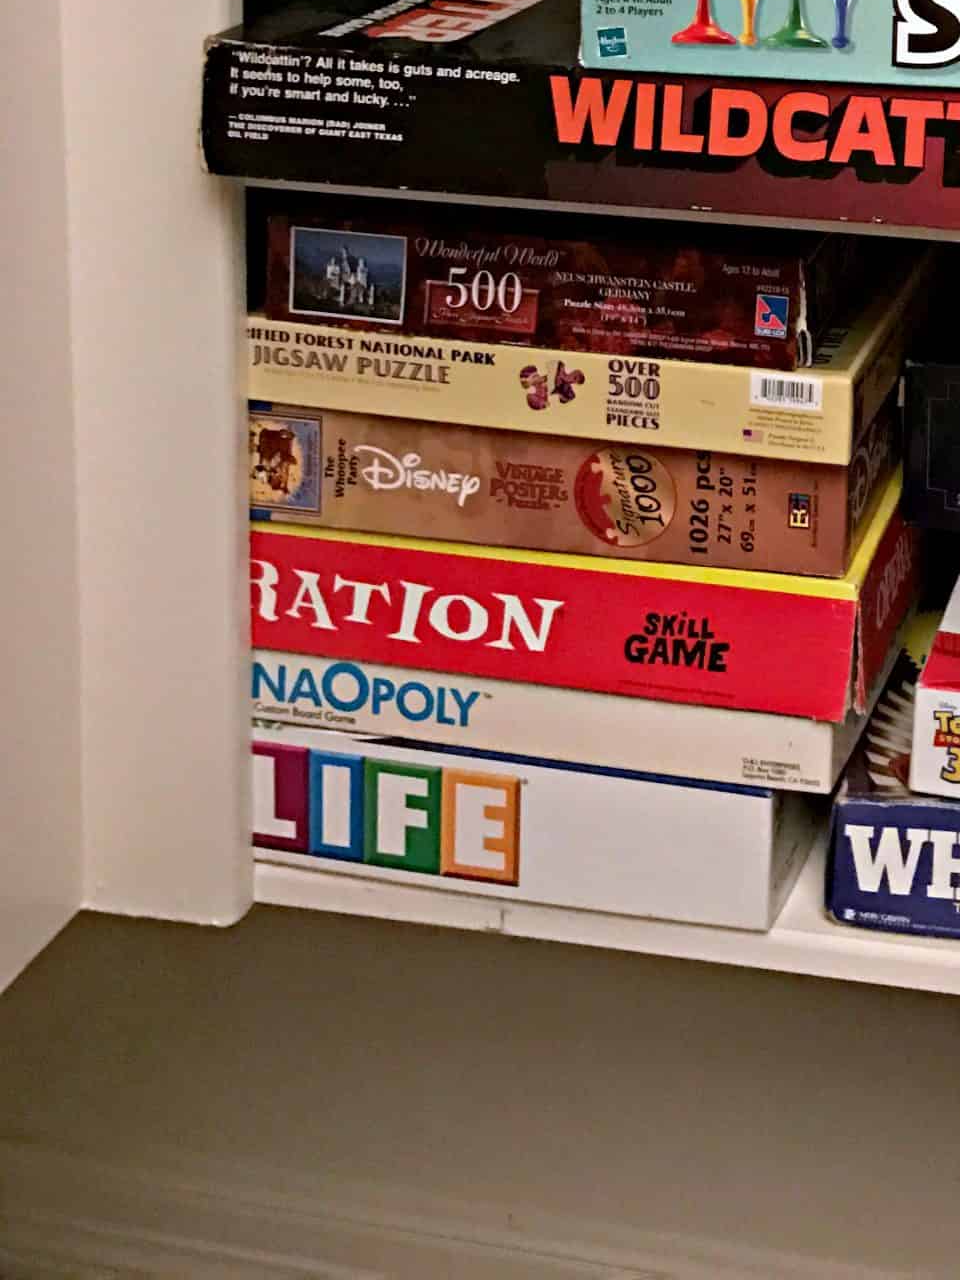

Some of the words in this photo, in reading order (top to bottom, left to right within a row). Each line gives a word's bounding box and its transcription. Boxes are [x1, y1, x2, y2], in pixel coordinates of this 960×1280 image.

[596, 5, 604, 15] 2
[605, 6, 616, 16] to
[617, 6, 626, 16] 4
[627, 6, 665, 17] Players
[230, 66, 239, 79] It
[242, 69, 283, 82] seems
[287, 71, 300, 83] to
[304, 72, 331, 87] help
[335, 75, 375, 91] some,
[378, 77, 404, 92] too,
[316, 57, 333, 69] All
[337, 58, 346, 70] it
[350, 59, 384, 73] takes
[388, 61, 400, 74] is
[403, 64, 433, 78] guts
[436, 67, 461, 79] and
[465, 69, 520, 84] acreage.
[241, 86, 281, 99] you're
[284, 89, 321, 101] smart
[324, 91, 350, 103] and
[227, 130, 242, 140] OIL
[244, 132, 270, 141] FIELD
[228, 121, 245, 130] THE
[247, 123, 303, 135] DISCOVERER
[304, 127, 316, 135] OF
[318, 129, 346, 138] GIANT
[348, 130, 372, 140] EAST
[373, 132, 404, 142] TEXAS
[415, 238, 500, 269] Wonderful
[502, 242, 561, 267] World
[446, 267, 522, 313] 500
[599, 286, 652, 300] GERMANY
[248, 328, 290, 344] IFIED
[295, 331, 354, 353] FOREST
[360, 339, 446, 362] NATIONAL
[451, 349, 496, 367] PARK
[252, 344, 349, 373] JIGSAW
[356, 356, 452, 385] PUZZLE
[608, 359, 661, 378] OVER
[608, 375, 661, 400] 500
[606, 413, 660, 431] PIECES
[324, 455, 336, 480] The
[335, 437, 349, 499] Whoopee
[347, 453, 360, 486] Party
[353, 444, 481, 508] Disney
[494, 461, 565, 484] VINTAGE
[614, 453, 641, 539] Signature
[630, 455, 665, 527] 1000
[745, 502, 757, 514] x
[688, 499, 710, 555] 1026
[623, 634, 731, 672] GAME
[251, 661, 482, 728] NAOPOLY
[292, 706, 323, 720] Board
[324, 711, 356, 725] Game
[252, 750, 511, 876] LIFE
